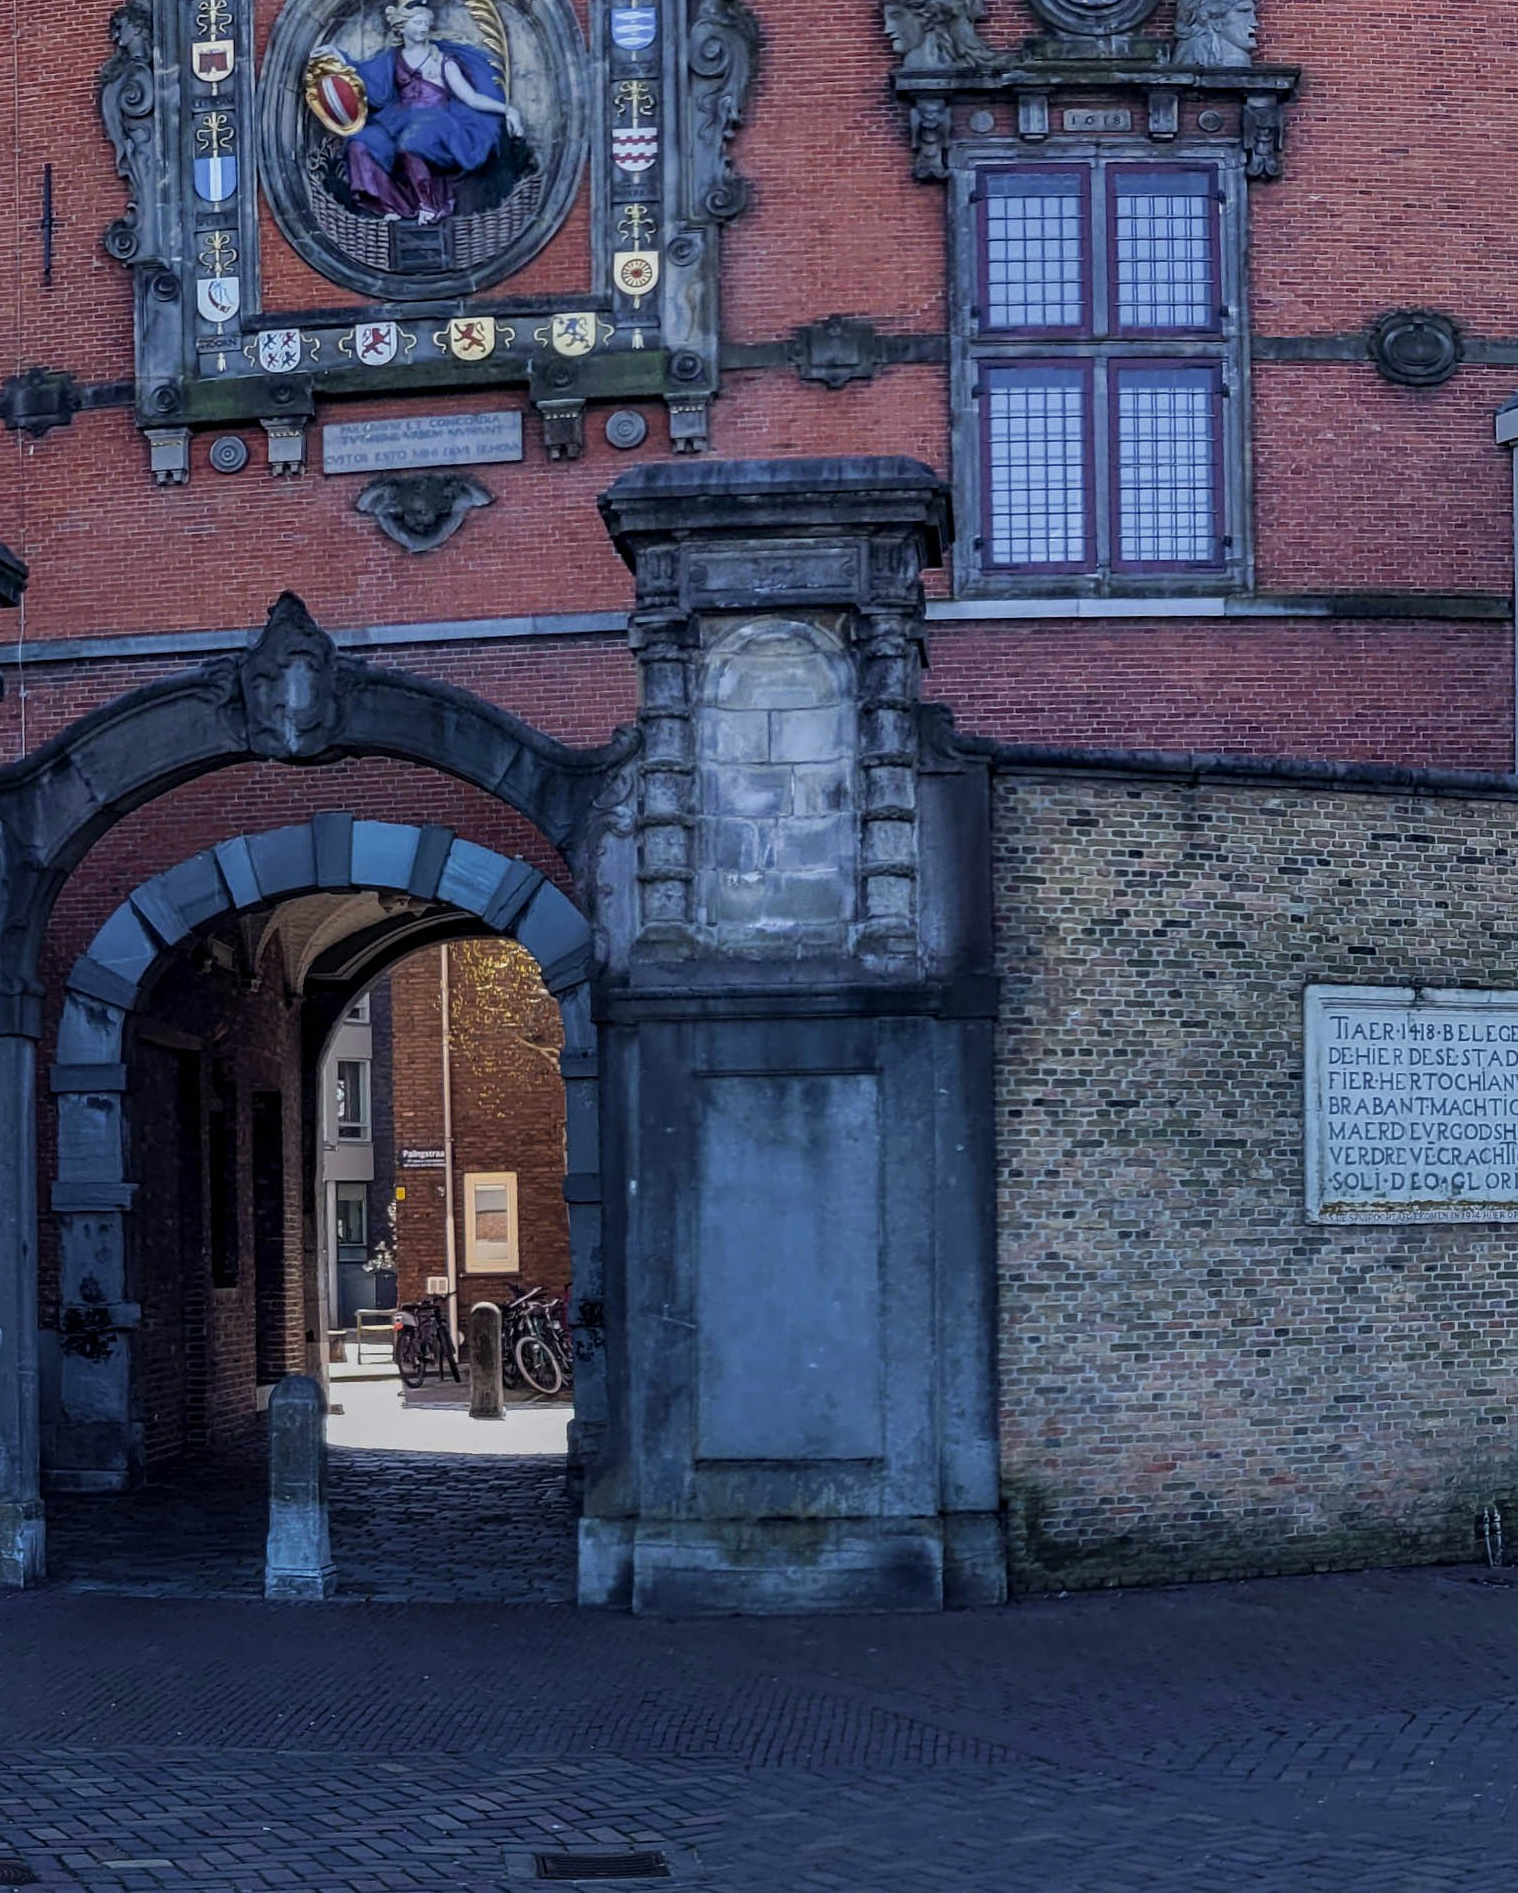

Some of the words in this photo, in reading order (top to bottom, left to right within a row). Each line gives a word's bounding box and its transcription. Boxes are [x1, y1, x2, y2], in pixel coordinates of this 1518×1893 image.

[1400, 1023, 1436, 1041] 1418
[403, 1149, 445, 1159] Palingstraa
[1391, 1172, 1440, 1191] DEO
